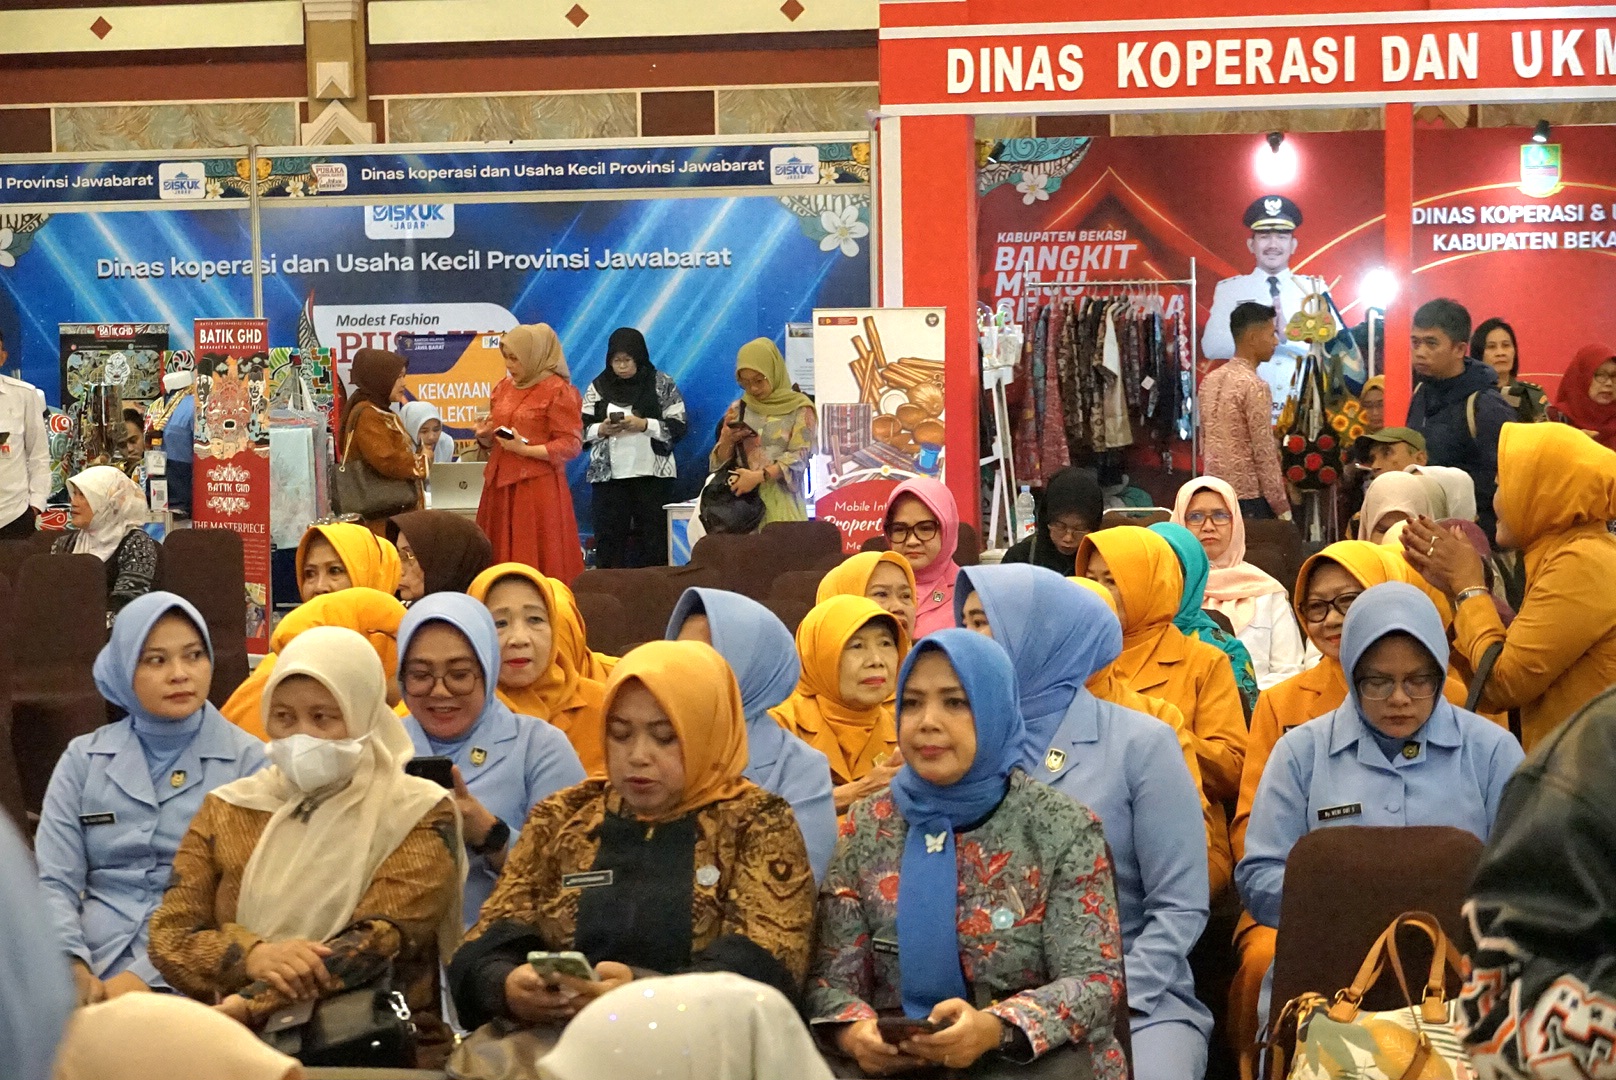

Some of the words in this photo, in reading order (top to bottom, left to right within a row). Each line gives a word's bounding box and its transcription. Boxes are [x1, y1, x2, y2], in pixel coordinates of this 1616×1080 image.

[947, 44, 1084, 94] DINAS
[1117, 35, 1356, 89] KOPERASI
[1381, 32, 1479, 83] DAN
[361, 168, 405, 181] Dinas
[408, 165, 476, 183] koperasi
[480, 165, 510, 178] dan
[514, 163, 564, 177] Usaha
[568, 162, 605, 176] Kecil
[609, 160, 675, 174] Provinsi
[678, 159, 765, 173] Jawabarat
[7, 175, 68, 189] Provinsi
[72, 174, 153, 188] Jawabarat
[373, 204, 445, 221] DISKUK
[1412, 206, 1475, 225] DINAS
[1480, 205, 1584, 224] KOPERASI
[1590, 204, 1606, 221] &
[997, 230, 1076, 243] KABUPATEN
[1079, 230, 1127, 241] BEKASI
[1433, 232, 1557, 251] KABUPATEN
[97, 257, 165, 278] Dinas
[171, 254, 277, 281] koperasi
[282, 255, 329, 274] dan
[336, 252, 414, 273] Usaha
[421, 249, 480, 271] Kecil
[487, 248, 589, 270] Provinsi
[595, 247, 731, 268] Jawabarat
[994, 244, 1138, 271] BANGKIT
[995, 270, 1087, 297] MAJU
[336, 314, 386, 327] Modest
[389, 313, 440, 326] Fashion
[199, 329, 234, 343] BATIK
[237, 328, 262, 343] GHD
[418, 382, 491, 400] KEKAYAAN
[207, 482, 232, 492] BATIK
[235, 483, 250, 493] GHD
[834, 500, 870, 511] Mobile
[210, 521, 266, 534] MASTERPIECE
[824, 515, 884, 537] Propert
